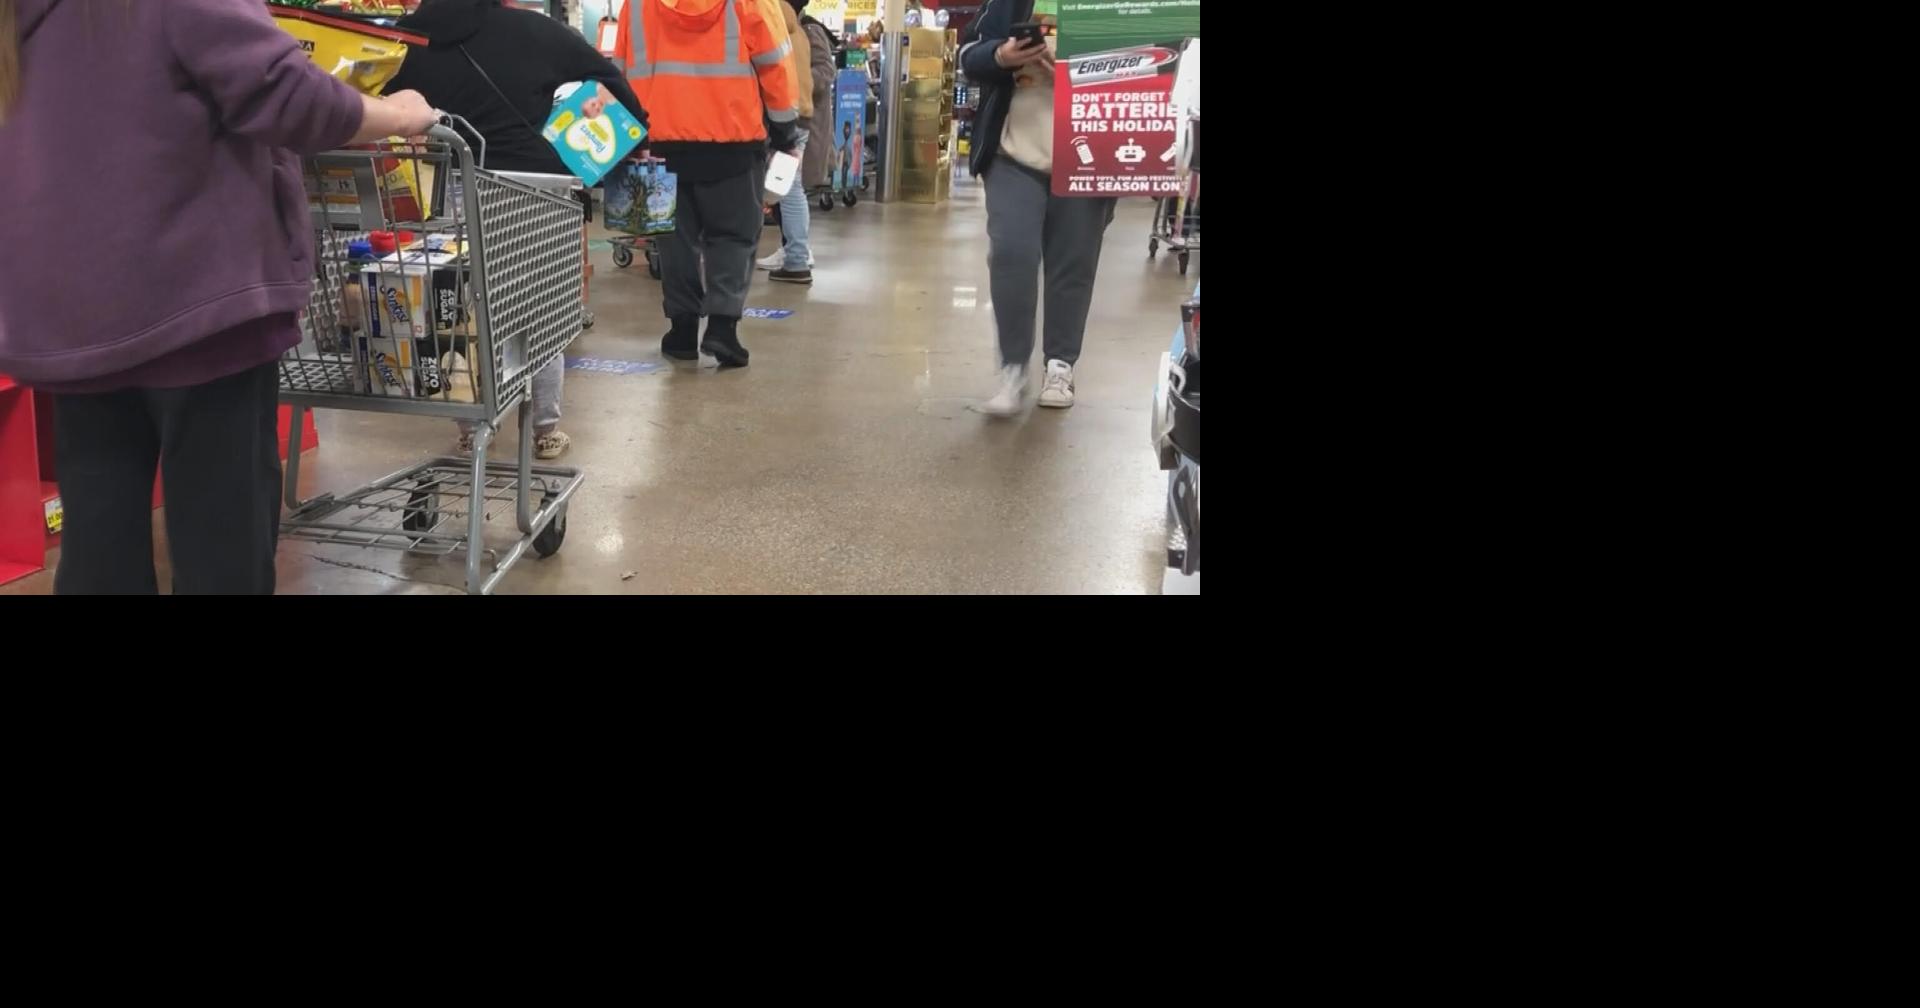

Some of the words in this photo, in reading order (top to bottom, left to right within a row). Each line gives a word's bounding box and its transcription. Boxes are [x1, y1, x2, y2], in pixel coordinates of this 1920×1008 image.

[1078, 55, 1143, 75] Energizer
[1072, 93, 1110, 103] DON'T
[1114, 92, 1165, 102] FORGET
[1071, 103, 1179, 119] BATTERIE
[1071, 121, 1108, 132] THIS
[1113, 120, 1177, 132] HOLIDA
[580, 124, 608, 153] Pampers
[1069, 181, 1093, 191] ALL
[1097, 181, 1149, 191] SEASON
[1153, 181, 1182, 191] LON
[380, 285, 411, 323] Sunkist
[440, 288, 449, 321] SUGAR
[375, 350, 401, 387] Sunkist
[428, 356, 441, 388] zero
